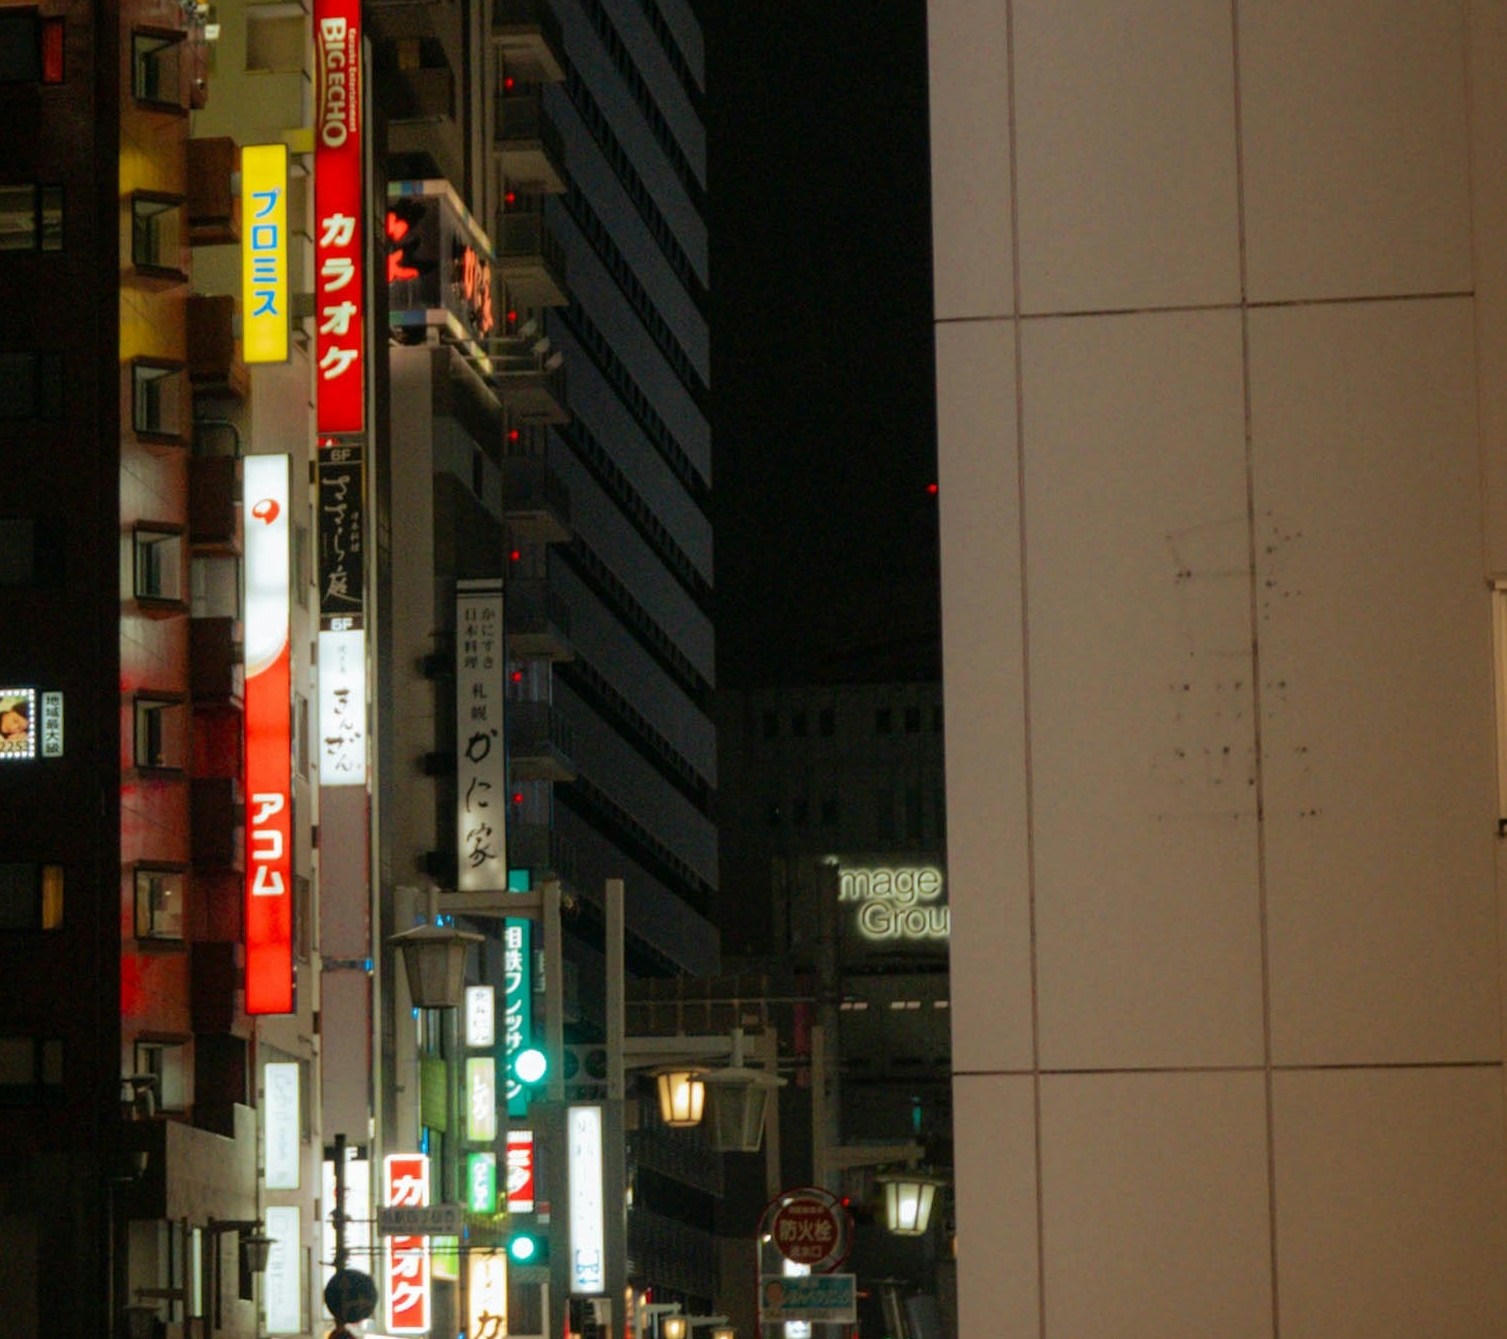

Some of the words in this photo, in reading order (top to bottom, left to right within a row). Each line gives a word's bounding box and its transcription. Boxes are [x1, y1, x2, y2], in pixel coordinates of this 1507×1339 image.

[321, 17, 347, 68] BIG
[322, 71, 347, 148] ECHO
[251, 187, 280, 317] プロミス
[319, 213, 358, 380] カラオケ
[252, 793, 284, 896] アコム
[466, 728, 498, 869] かに家
[837, 868, 942, 906] mage
[392, 1174, 423, 1313] カオケ
